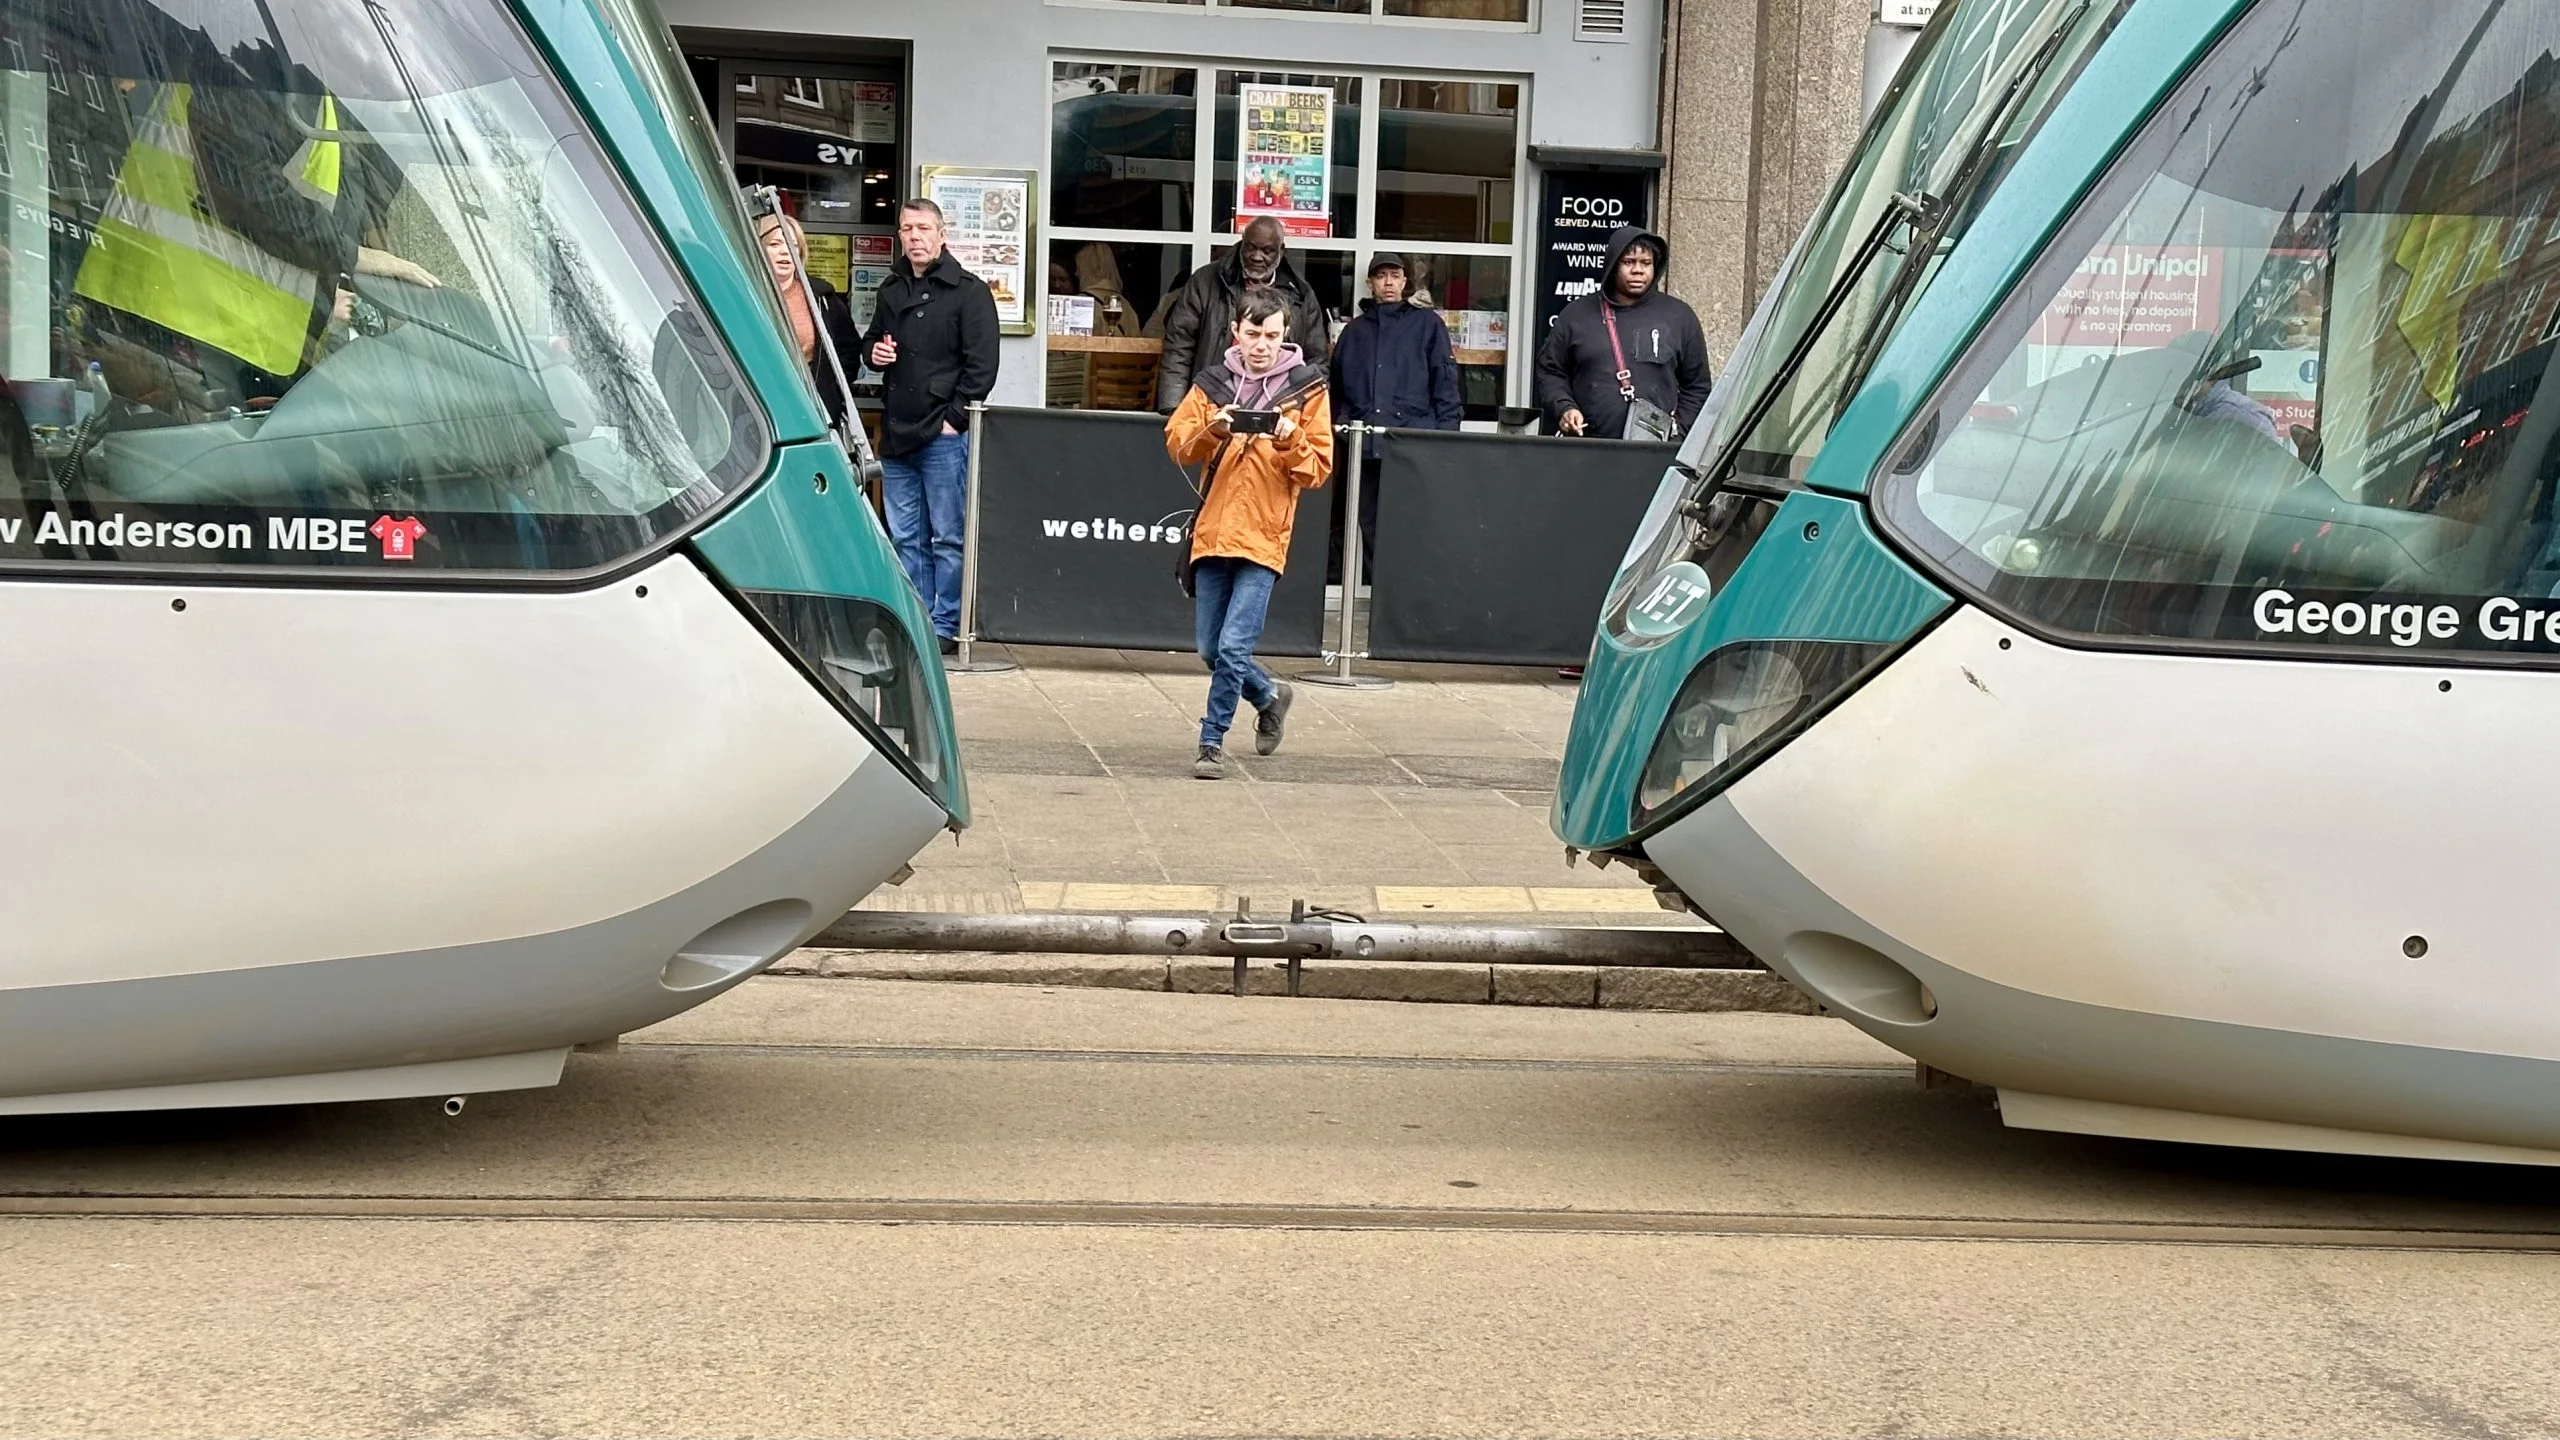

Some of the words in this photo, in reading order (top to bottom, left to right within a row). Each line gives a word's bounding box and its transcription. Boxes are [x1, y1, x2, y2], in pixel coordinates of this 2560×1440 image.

[1901, 4, 1913, 15] at
[1249, 91, 1287, 106] CRAFT
[1289, 93, 1324, 108] BEERS
[1561, 196, 1623, 216] FOOD
[1554, 218, 1589, 228] SERVED
[1591, 220, 1608, 228] ALL
[1552, 242, 1586, 251] AWARD
[2126, 254, 2209, 281] Unipol
[2058, 288, 2102, 302] Quality
[2105, 289, 2147, 300] student
[2150, 290, 2195, 303] housing
[2054, 304, 2081, 315] with
[2084, 306, 2100, 315] no
[2131, 307, 2147, 316] no
[2080, 321, 2088, 331] &
[2090, 322, 2105, 331] no
[2107, 321, 2172, 333] guarantors
[34, 511, 251, 549] Anderson
[268, 517, 366, 553] MBE
[1042, 517, 1189, 544] wethers
[2253, 588, 2460, 647] George
